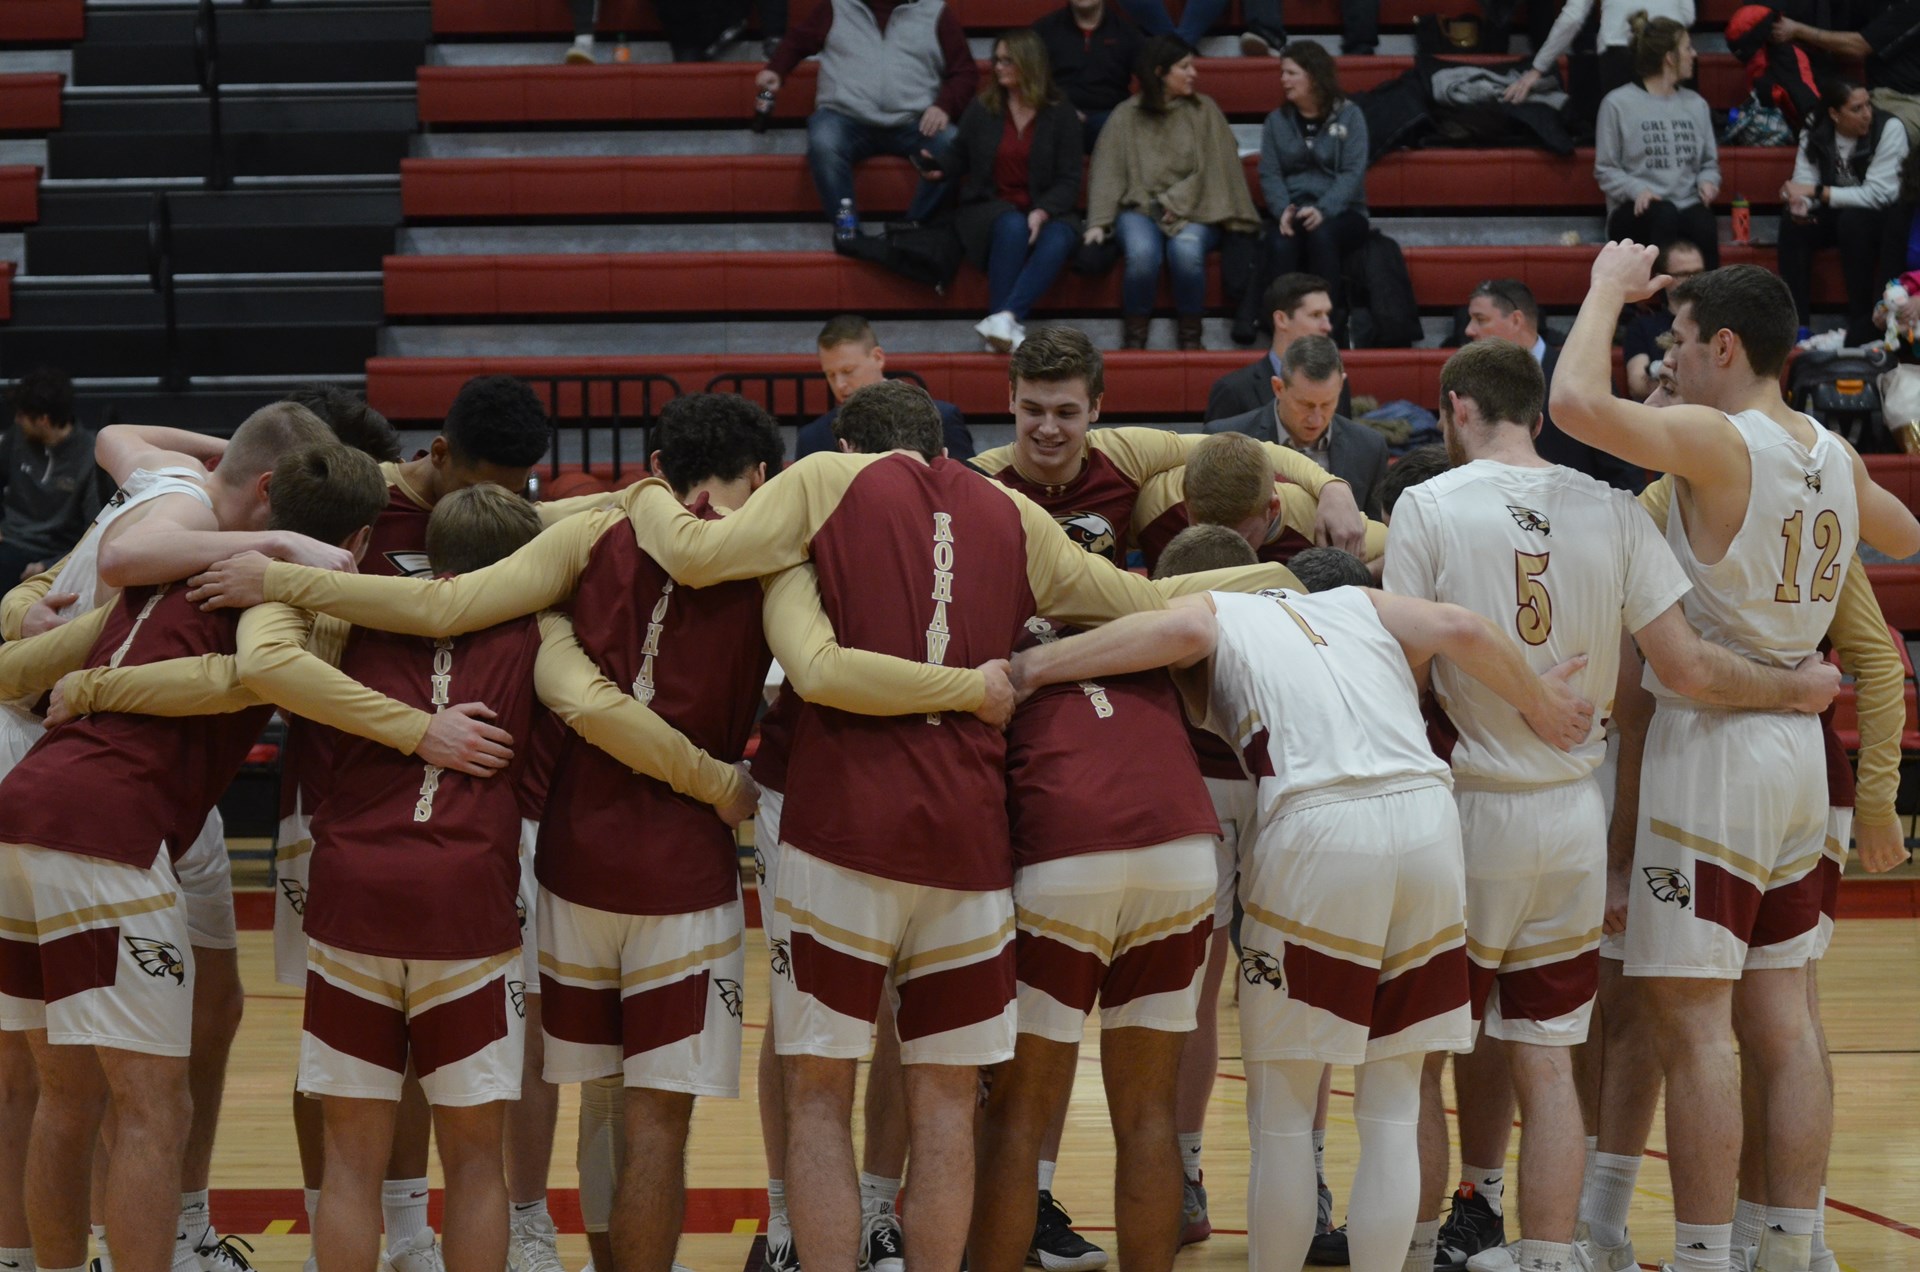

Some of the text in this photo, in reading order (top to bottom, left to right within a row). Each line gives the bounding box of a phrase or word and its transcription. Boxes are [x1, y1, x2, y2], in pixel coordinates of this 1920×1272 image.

[1515, 548, 1552, 646] 5
[1774, 509, 1842, 603] 12
[926, 512, 954, 726] KOHAW
